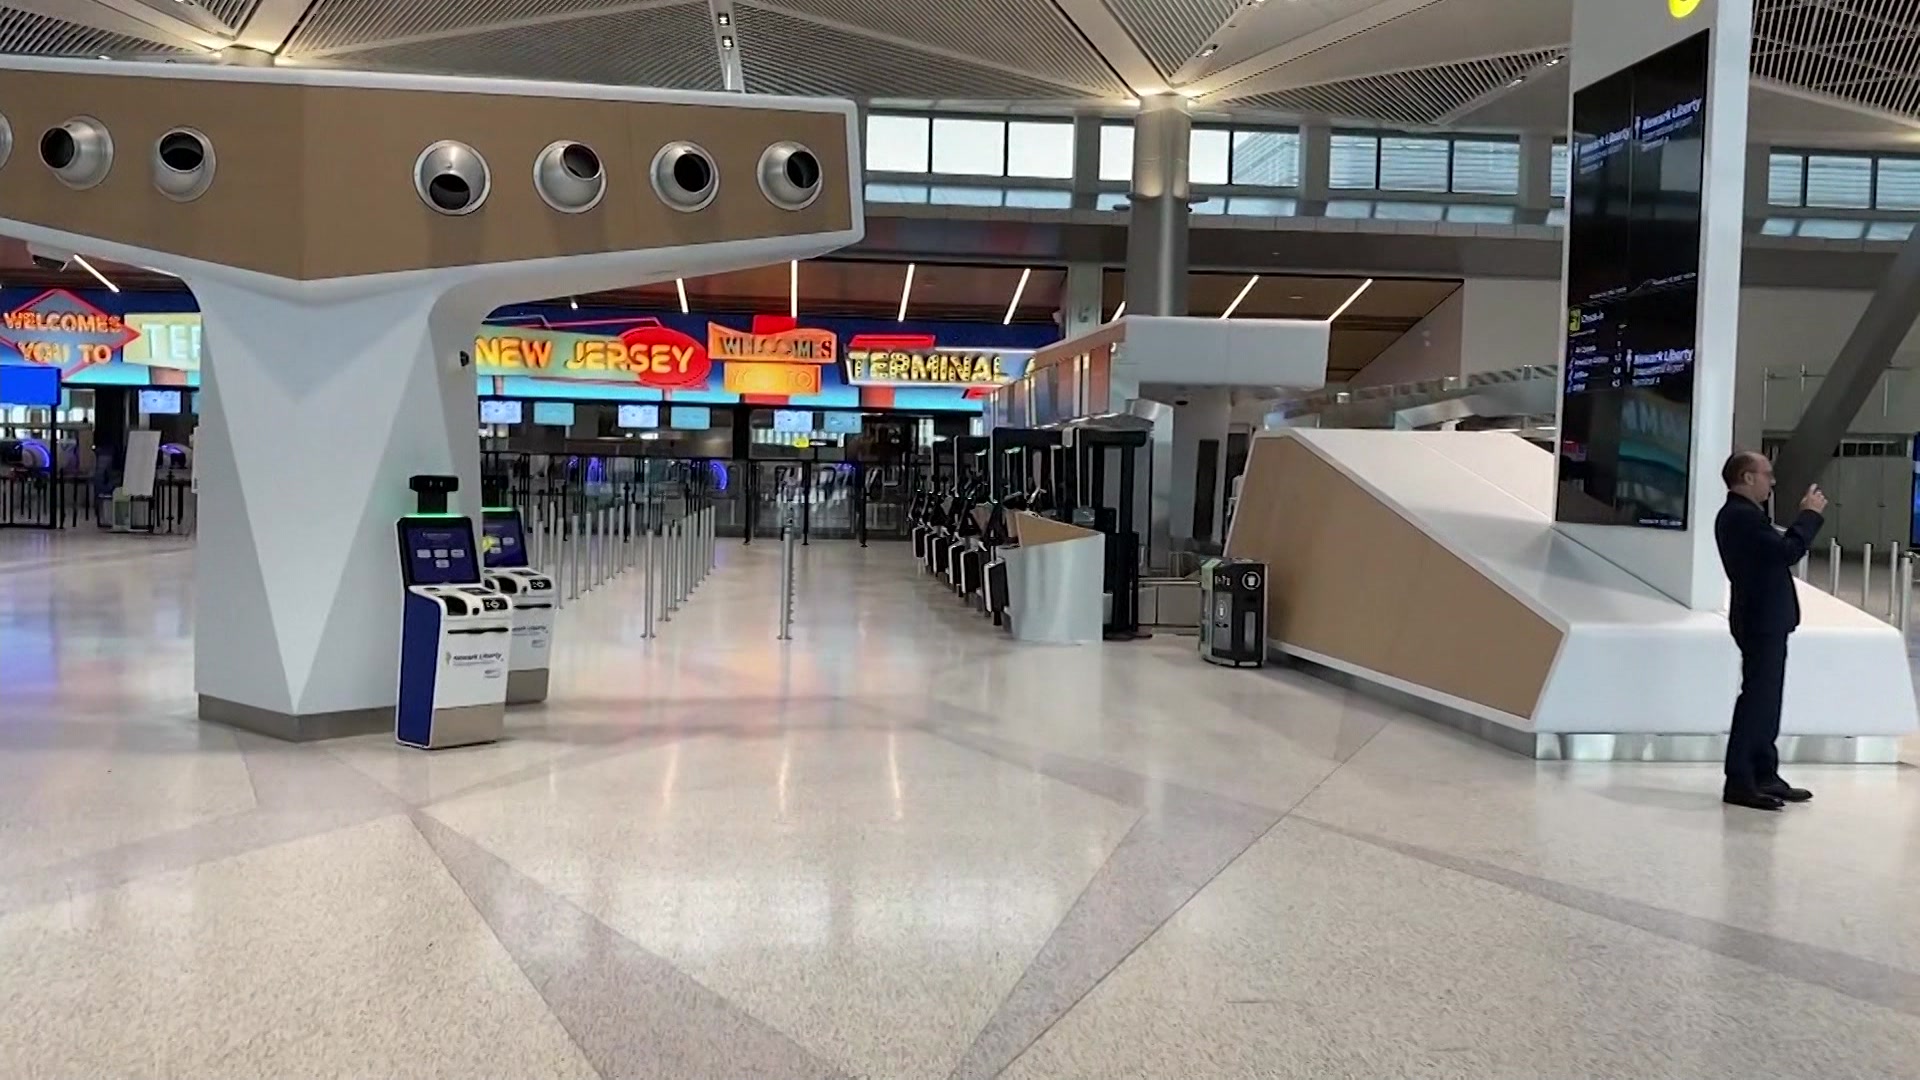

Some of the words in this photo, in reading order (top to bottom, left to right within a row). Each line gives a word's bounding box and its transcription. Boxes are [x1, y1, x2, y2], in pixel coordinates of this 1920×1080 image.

[3, 312, 122, 333] WELCOMES
[17, 341, 70, 364] YOU
[77, 344, 112, 364] TO
[475, 336, 552, 368] NEW
[564, 340, 694, 373] JERSEY
[720, 336, 832, 359] WELCOMES
[848, 351, 1011, 383] TERMINAL
